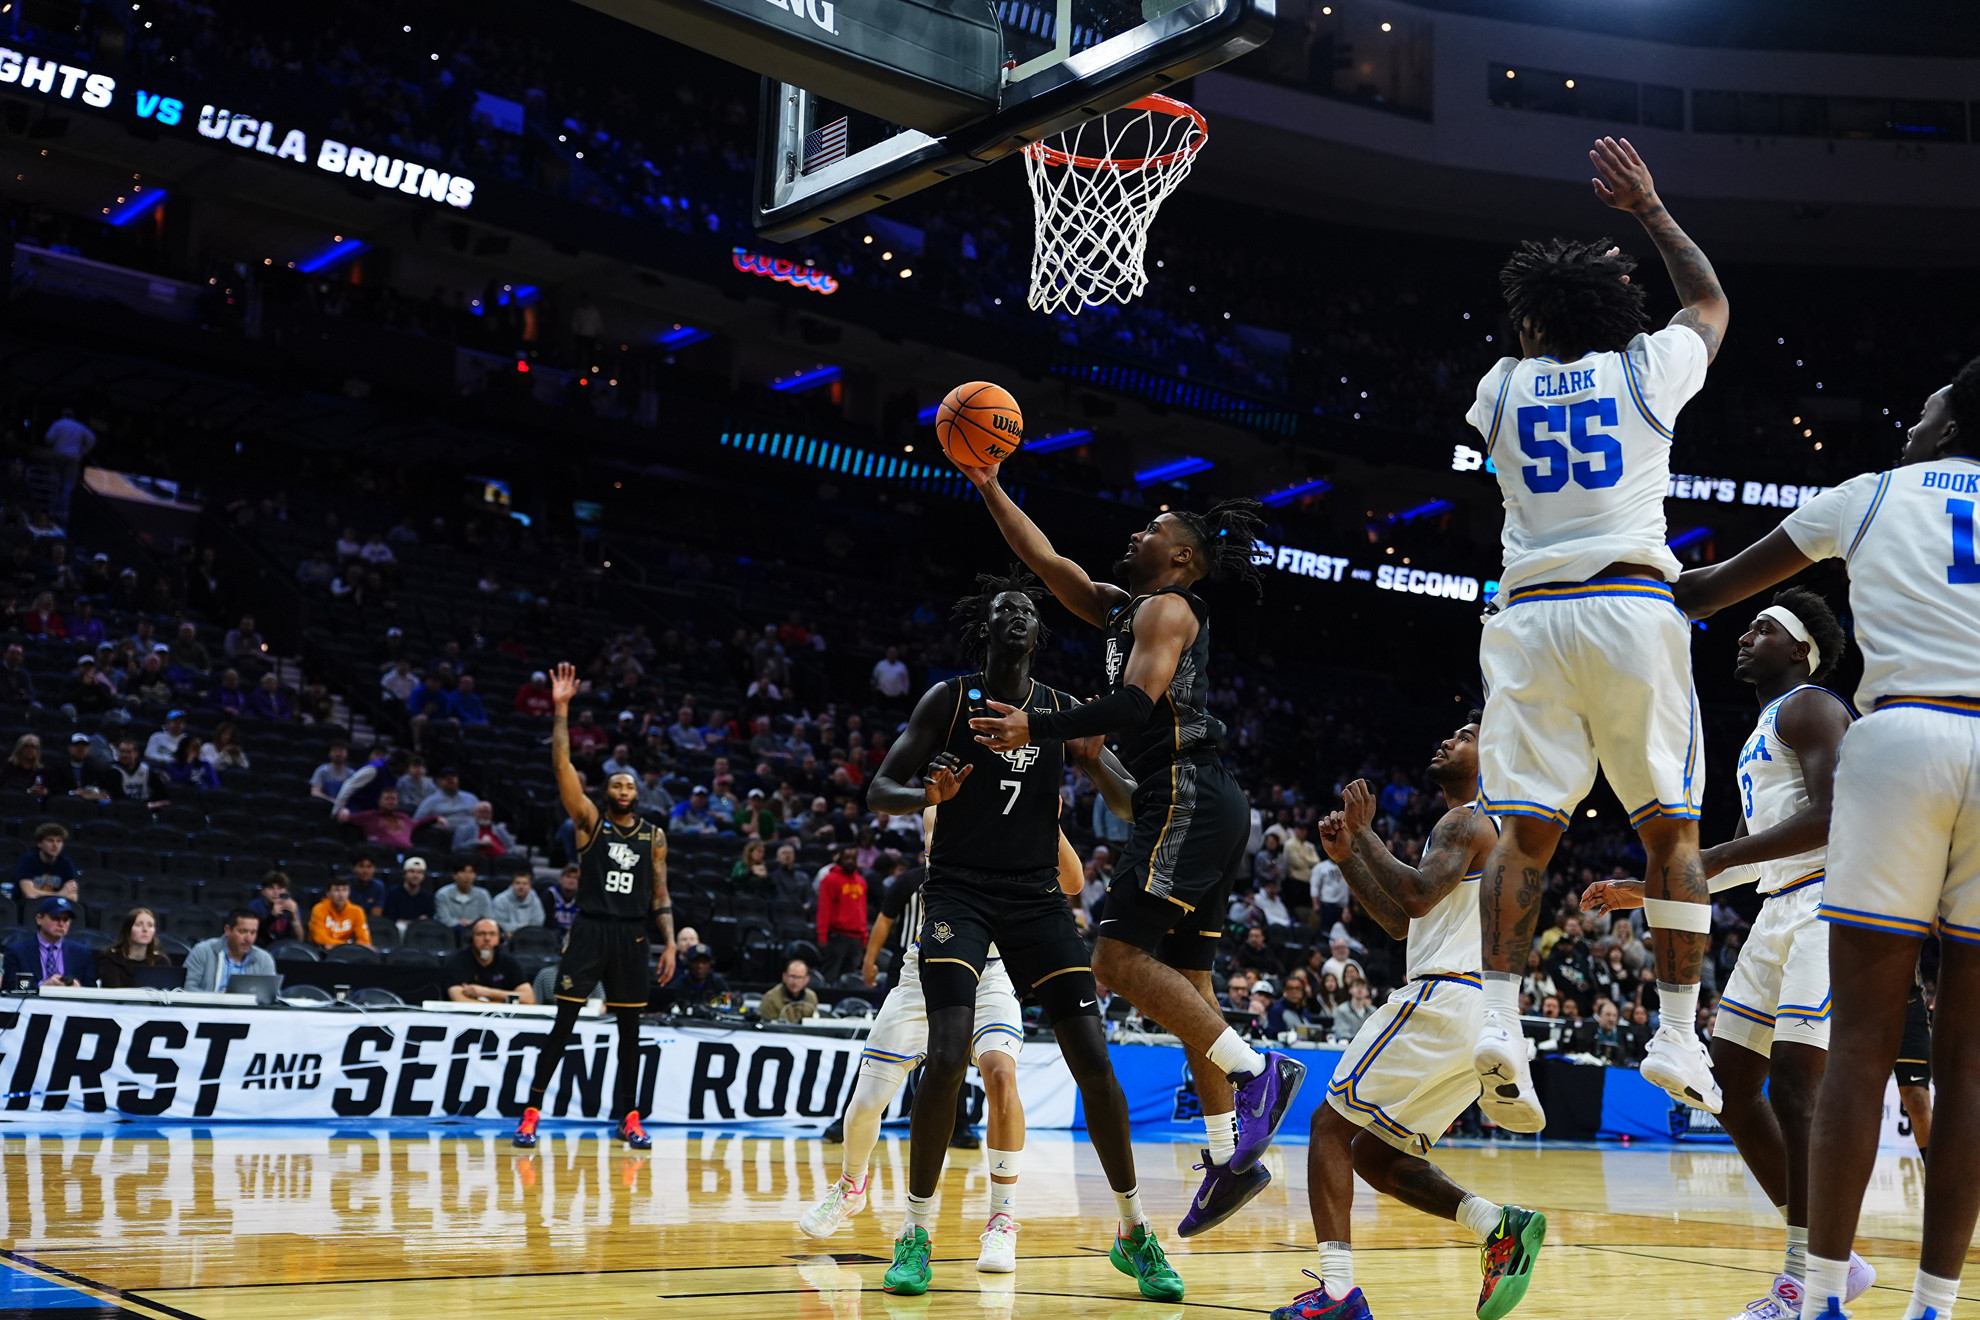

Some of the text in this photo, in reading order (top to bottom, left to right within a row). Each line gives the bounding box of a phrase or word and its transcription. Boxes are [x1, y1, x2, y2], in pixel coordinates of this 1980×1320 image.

[198, 104, 307, 163] UCLA
[317, 139, 475, 209] BRUINS
[1534, 368, 1596, 397] CLARK
[1517, 397, 1624, 494] 55
[1667, 473, 1737, 503] EN'S
[1276, 545, 1349, 582] FIRST
[1375, 564, 1479, 602] SECOND
[1000, 779, 1022, 815] 7
[604, 870, 634, 894] 99
[241, 1053, 322, 1090] AND
[331, 1025, 662, 1118] SECOND
